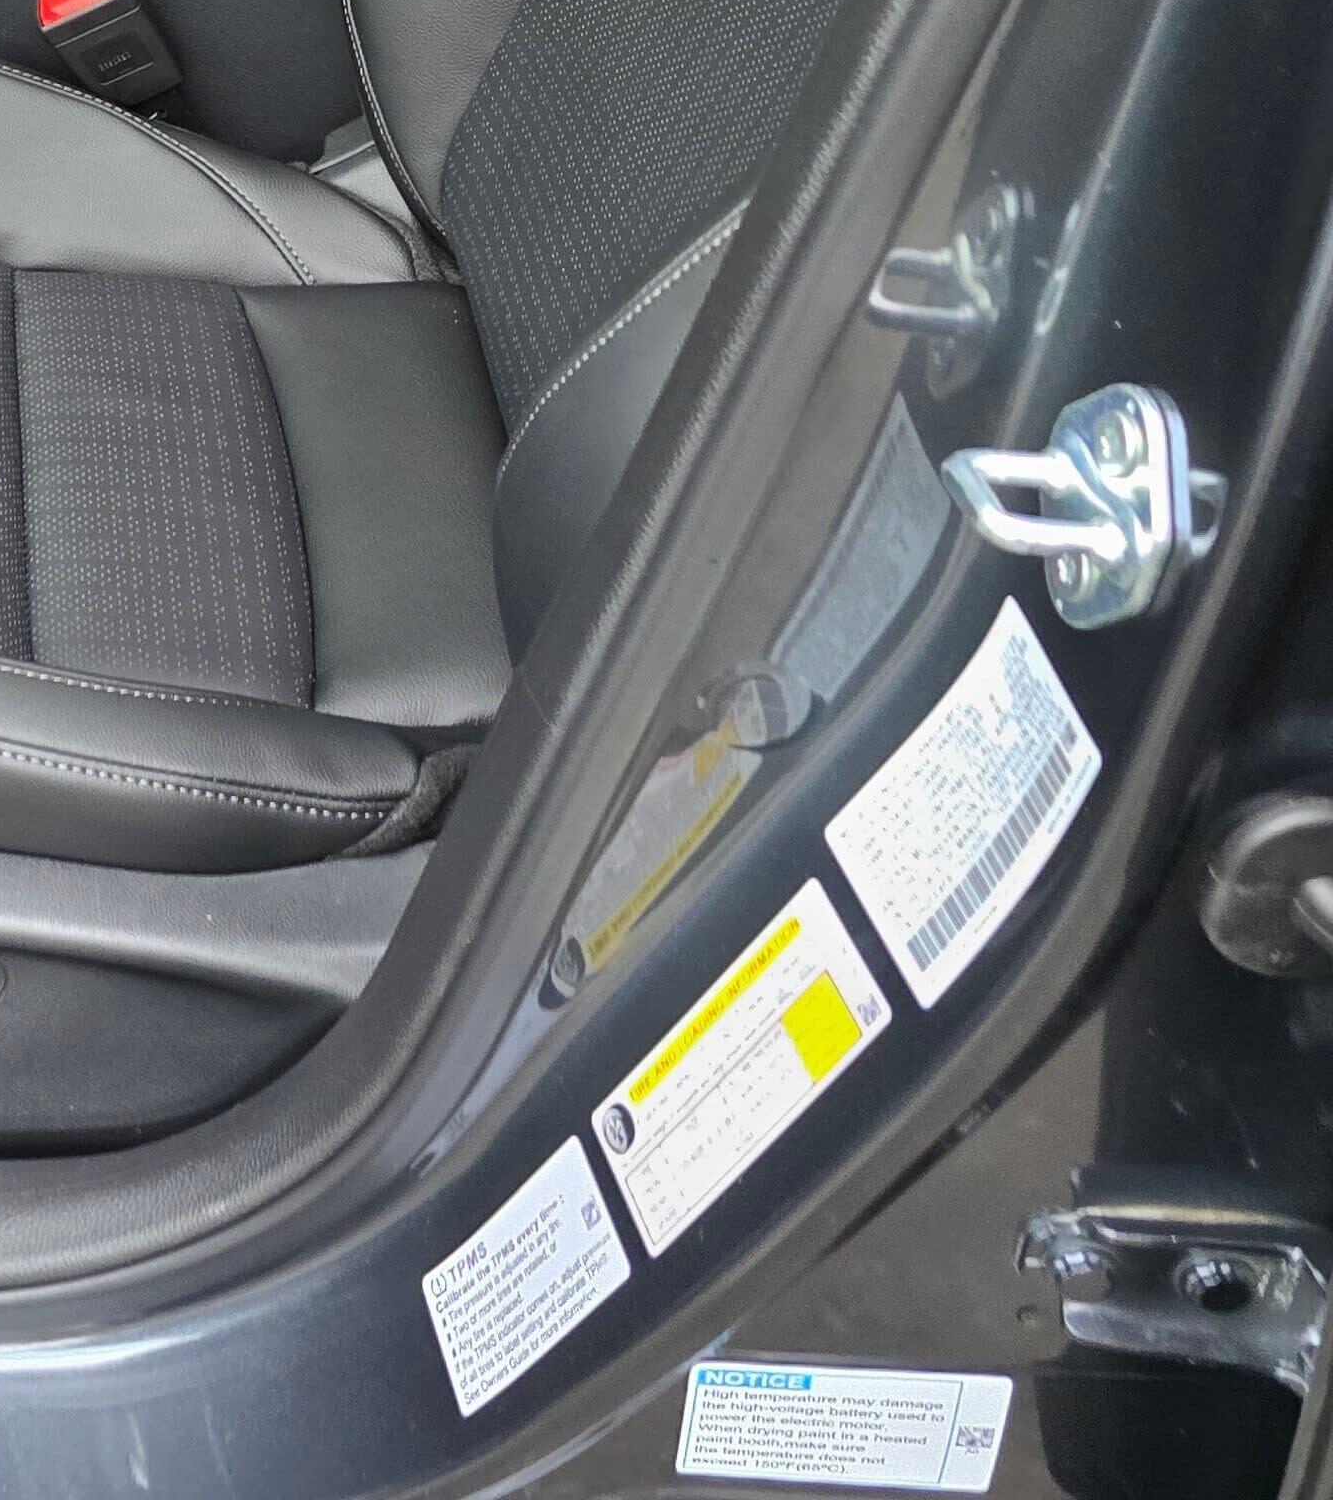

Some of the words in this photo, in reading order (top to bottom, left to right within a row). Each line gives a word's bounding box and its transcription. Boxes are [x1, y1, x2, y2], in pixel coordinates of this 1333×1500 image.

[652, 1047, 678, 1079] AND
[724, 915, 801, 1002] INFORMATION
[434, 1270, 476, 1319] Calibrate
[474, 1259, 491, 1283] the
[490, 1237, 516, 1269] TPMS
[515, 1217, 541, 1248] every
[446, 1237, 488, 1288] TPMS
[448, 1303, 464, 1326] Tire
[462, 1276, 494, 1314] pressure
[452, 1316, 470, 1340] Two
[468, 1310, 479, 1327] or
[477, 1294, 497, 1320] more
[456, 1333, 474, 1358] Any
[472, 1323, 486, 1343] tire
[460, 1351, 475, 1372] the
[473, 1332, 497, 1362] TPMS
[495, 1307, 526, 1343] indicator
[458, 1375, 469, 1392] of
[467, 1366, 479, 1385] all
[477, 1353, 496, 1378] tires
[501, 1332, 521, 1358] label
[462, 1382, 481, 1408] See
[507, 1341, 531, 1372] Guide
[529, 1334, 541, 1353] for
[703, 1369, 805, 1390] NOTICE
[701, 1399, 726, 1411] the
[729, 1401, 825, 1418] high-voltage
[827, 1406, 883, 1422] battery
[886, 1410, 927, 1422] used
[929, 1412, 946, 1423] to
[703, 1387, 740, 1402] High
[743, 1390, 838, 1408] temperature
[840, 1395, 876, 1409] may
[878, 1397, 945, 1413] damage
[696, 1422, 743, 1435] When
[745, 1424, 795, 1440] drying
[796, 1428, 838, 1442] paint
[839, 1430, 856, 1441] in
[858, 1433, 870, 1442] a
[872, 1432, 929, 1446] heated
[698, 1412, 746, 1424] power
[750, 1414, 776, 1425] the
[778, 1415, 835, 1429] electric
[693, 1444, 719, 1455] the
[721, 1445, 815, 1462] temperature
[817, 1452, 858, 1464] does
[859, 1455, 887, 1466] not
[694, 1432, 734, 1446] paint
[830, 1442, 867, 1453] sure
[691, 1454, 748, 1468] exceed
